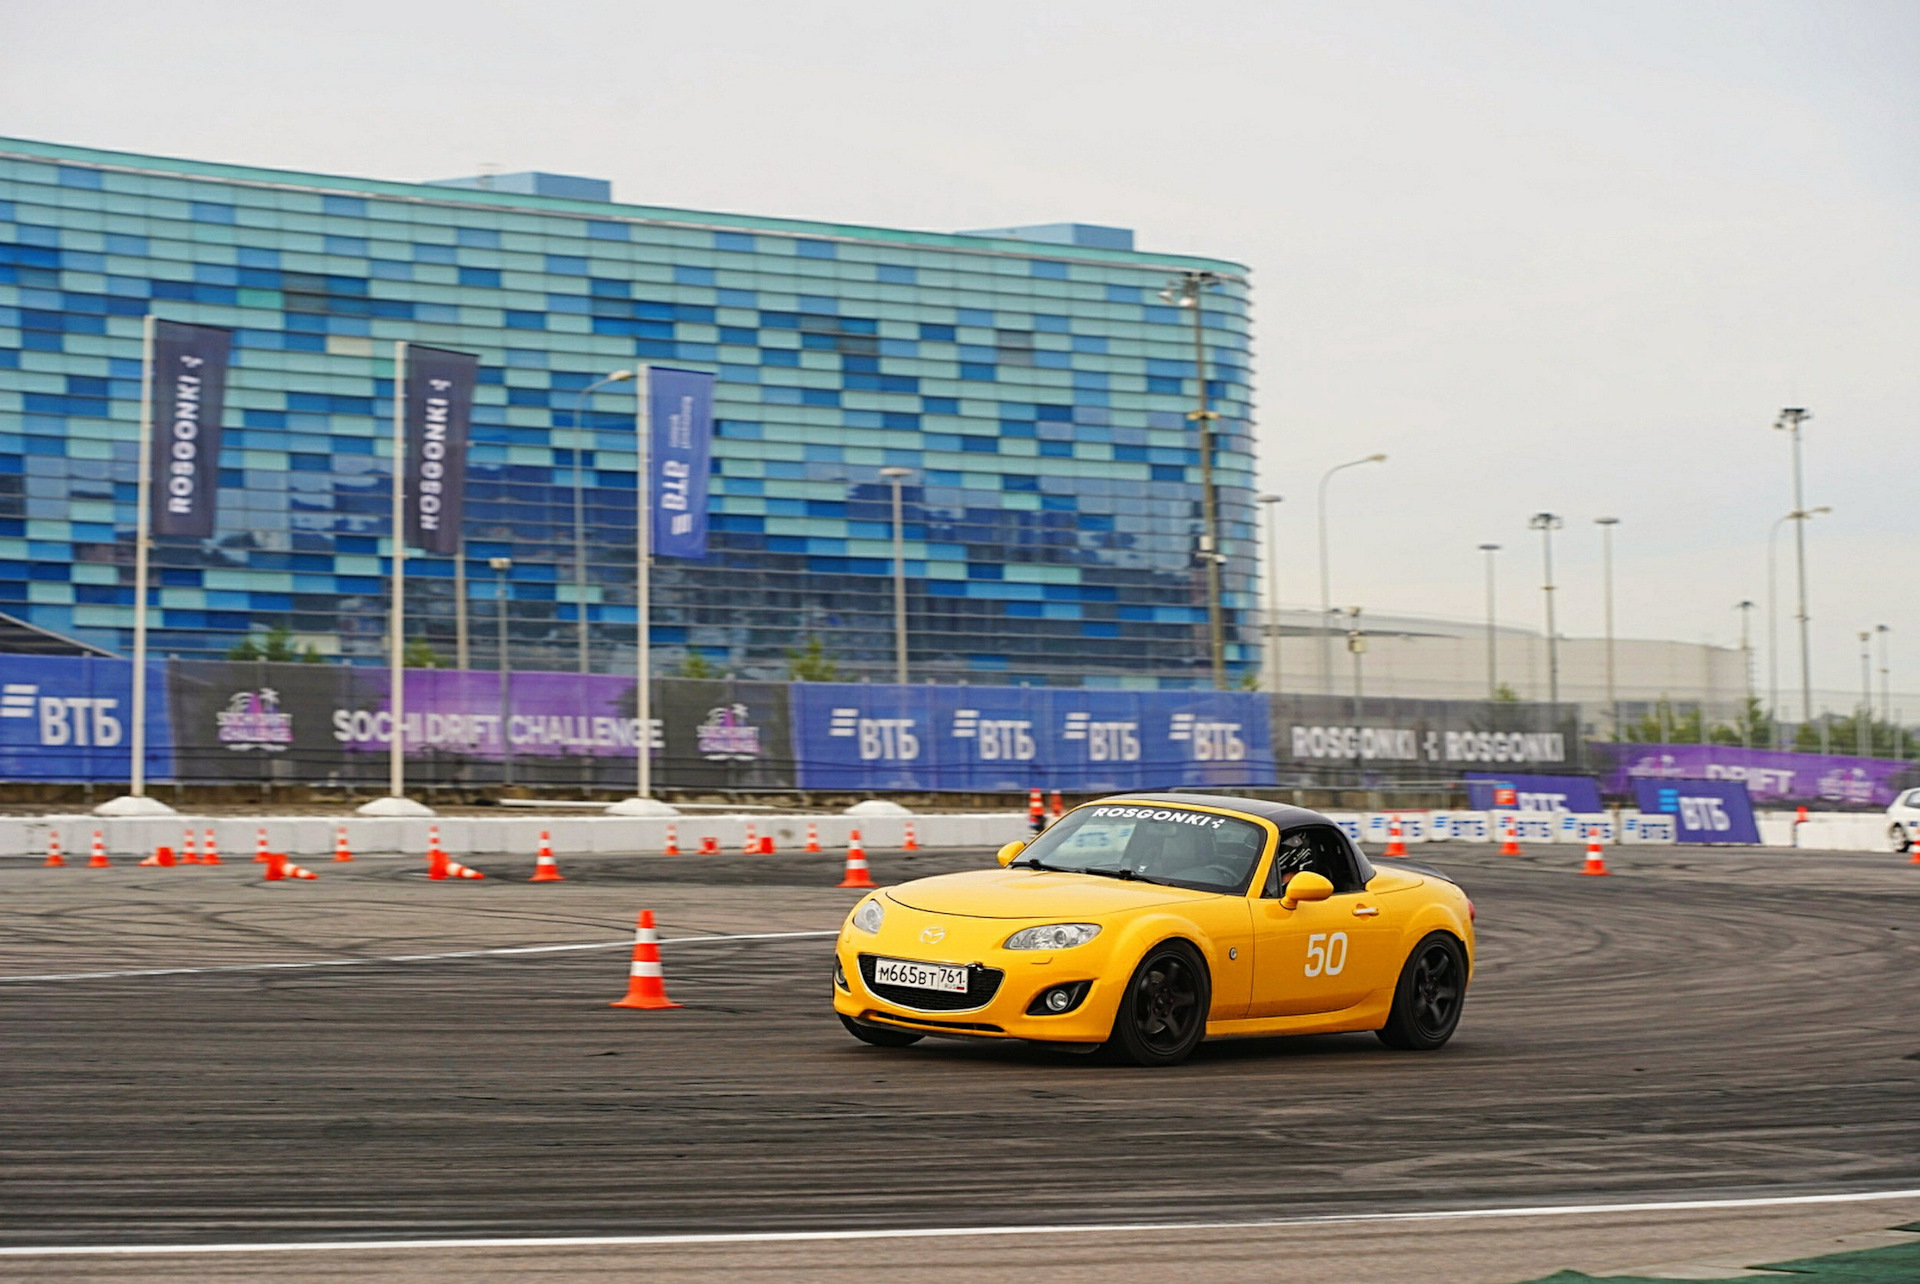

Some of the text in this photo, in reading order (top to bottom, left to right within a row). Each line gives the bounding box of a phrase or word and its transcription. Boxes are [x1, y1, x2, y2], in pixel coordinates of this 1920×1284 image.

[39, 697, 122, 747] ВТБ
[332, 708, 423, 743] SOCHI
[426, 711, 501, 745] DRIFT
[507, 714, 666, 749] CHALLENGE
[858, 718, 920, 760] ВТБ
[979, 719, 1036, 760] ВТБ
[1088, 721, 1141, 761] ВТБ
[1193, 722, 1245, 761] ВТБ
[1091, 806, 1212, 826] ROSGONKI
[1678, 796, 1731, 832] ВТБ
[1304, 931, 1348, 978] 50
[879, 964, 963, 986] М665ВТ 761
